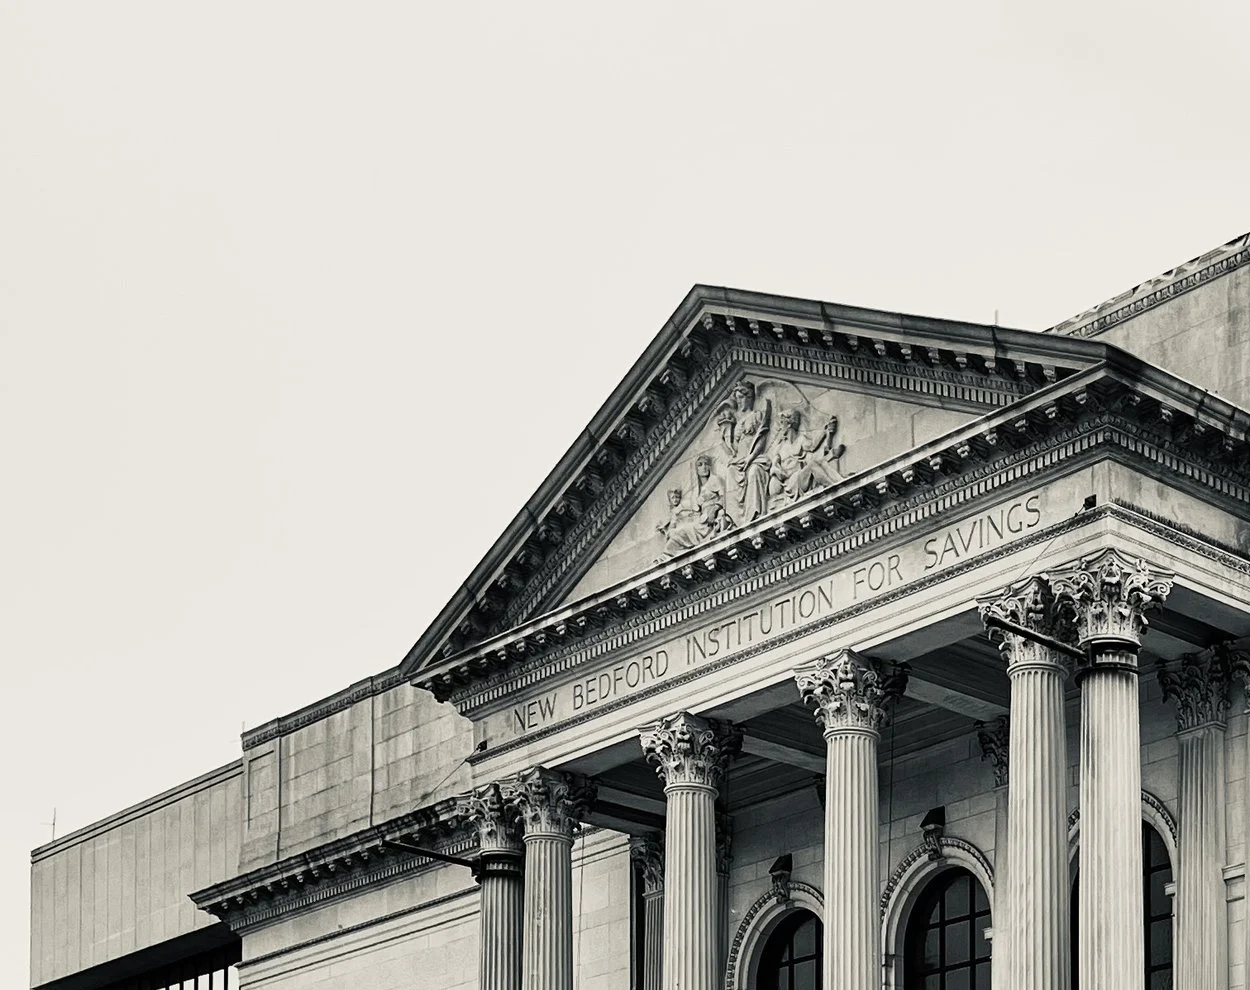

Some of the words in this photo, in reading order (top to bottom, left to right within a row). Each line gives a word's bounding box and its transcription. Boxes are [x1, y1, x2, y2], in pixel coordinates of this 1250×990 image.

[513, 693, 557, 734] NEW
[573, 650, 669, 711] BEDFORD
[686, 580, 833, 665] INSTITUTION
[853, 554, 903, 600] FOR
[923, 495, 1041, 571] SAVINGS
